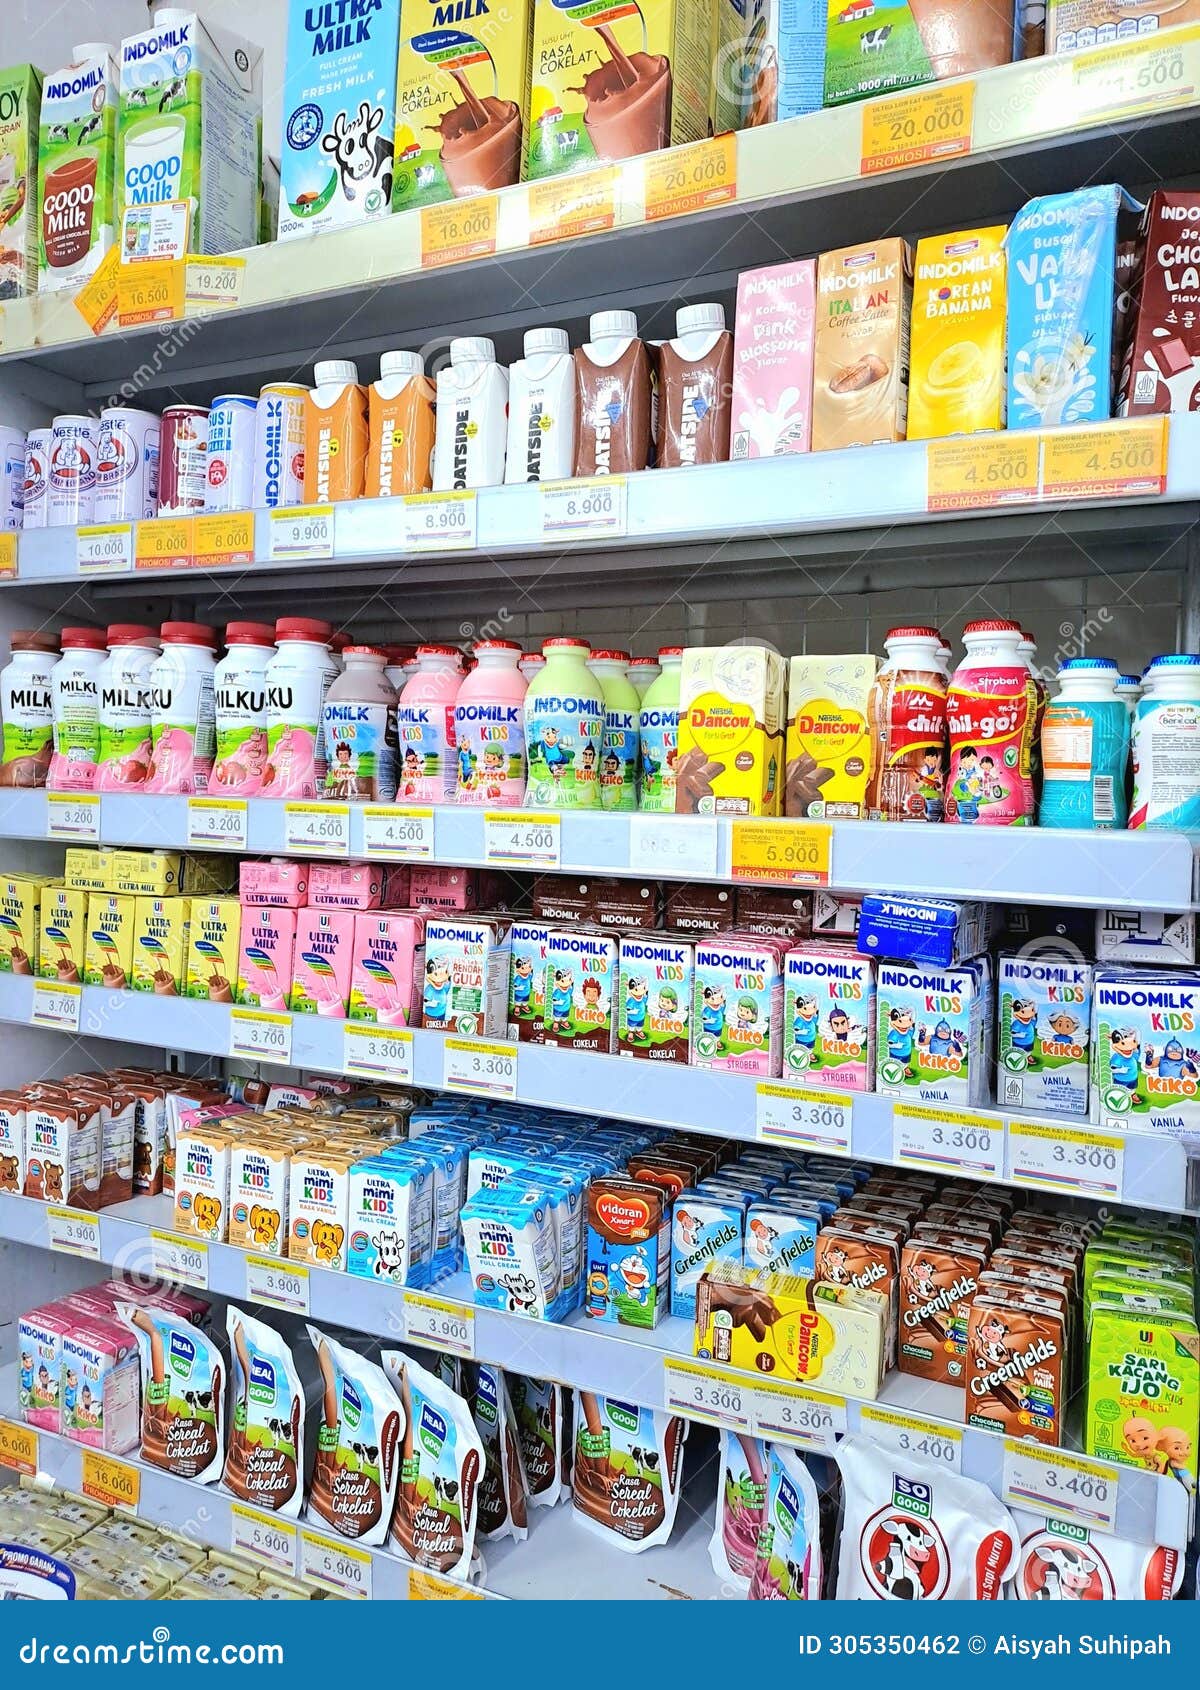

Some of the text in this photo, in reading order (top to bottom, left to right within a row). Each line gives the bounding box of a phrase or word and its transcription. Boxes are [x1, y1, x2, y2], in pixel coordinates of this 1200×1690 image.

[124, 24, 189, 62] INDOMILK
[312, 20, 373, 56] MILK
[320, 51, 362, 70] FULL CREAM
[540, 44, 573, 62] RASA
[540, 50, 592, 75] COKELAT
[302, 70, 375, 100] FRESH MILK
[402, 85, 430, 102] RASA
[401, 91, 448, 114] COKELAT
[890, 109, 964, 140] 20.000
[866, 150, 920, 170] PROMOSI
[126, 156, 180, 188] GOOD
[666, 160, 726, 190] 20.000
[43, 184, 93, 212] GOOD
[132, 180, 172, 204] Milk
[48, 206, 86, 234] Milk
[440, 216, 490, 240] 18.000
[919, 252, 1000, 280] INDOMILK
[198, 274, 236, 290] 19.200
[131, 288, 168, 304] 16.500
[928, 279, 992, 303] KOREAN
[828, 290, 889, 315] ITALIAN
[926, 296, 992, 319] BANANA
[120, 312, 152, 324] PROMOSI
[1085, 448, 1155, 472] 4.500
[964, 461, 1028, 484] 4.500
[1051, 484, 1118, 496] PROMOSI
[567, 498, 612, 516] 8.900
[931, 494, 994, 508] PROMOSI
[426, 512, 466, 529] 8.900
[215, 533, 248, 548] 8.000
[292, 524, 328, 540] 9.900
[88, 542, 124, 556] 10.000
[156, 538, 188, 550] 8.000
[138, 558, 171, 568] PROMOSI
[196, 554, 229, 566] PROMOSI
[691, 709, 750, 728] Dancow
[800, 716, 860, 734] Dancow
[64, 811, 93, 824] 3.200
[208, 817, 241, 831] 3.200
[306, 822, 342, 836] 4.500
[385, 826, 424, 840] 4.500
[510, 833, 553, 848] 4.500
[766, 846, 819, 863] 5.900
[737, 869, 788, 881] PROMOSI
[1, 897, 24, 910] ULTRA
[246, 894, 289, 904] ULTRA MILK
[315, 895, 360, 905] ULTRA MILK
[50, 908, 73, 920] ULTRA
[146, 917, 171, 928] ULTRA
[148, 927, 168, 938] MILK
[201, 921, 227, 933] ULTRA
[251, 928, 279, 940] ULTRA
[427, 926, 484, 944] INDOMILK
[203, 931, 224, 942] MILK
[254, 938, 276, 950] MILK
[309, 932, 340, 944] ULTRA
[368, 938, 398, 952] ULTRA
[312, 943, 337, 955] MILK
[549, 937, 609, 956] INDOMILK
[622, 945, 684, 963] INDOMILK
[372, 950, 395, 962] MILK
[697, 952, 766, 972] INDOMILK
[452, 962, 483, 974] RENDAH
[788, 959, 863, 980] INDOMILK
[452, 972, 482, 987] GULA
[881, 971, 963, 994] INDOMILK
[48, 999, 76, 1015] 3.700
[1099, 989, 1194, 1010] INDOMILK
[251, 1029, 285, 1046] 3.700
[572, 1038, 598, 1048] COKELAT
[368, 1042, 405, 1059] 3.300
[648, 1048, 676, 1059] COKELAT
[472, 1056, 512, 1076] 3.300
[727, 1059, 760, 1070] STROBERI
[822, 1072, 857, 1083] STROBERI
[1042, 1076, 1071, 1086] VANILA
[920, 1090, 949, 1101] VANILA
[792, 1106, 844, 1128] 3.300
[1150, 1117, 1185, 1128] VANILA
[35, 1124, 57, 1135] mimi
[36, 1133, 58, 1147] KIDS
[932, 1128, 991, 1152] 3.300
[187, 1152, 213, 1166] mimi
[1052, 1145, 1116, 1170] 3.300
[187, 1162, 212, 1177] KIDS
[242, 1162, 270, 1176] mimi
[242, 1173, 270, 1189] KIDS
[304, 1176, 334, 1190] mimi
[304, 1187, 334, 1203] KIDS
[363, 1186, 394, 1200] mimi
[362, 1198, 394, 1214] KIDS
[601, 1204, 643, 1219] vidoran
[610, 1216, 635, 1226] Xmart
[66, 1225, 96, 1242] 3.900
[479, 1230, 513, 1244] mimi
[480, 1241, 516, 1258] KIDS
[674, 1223, 739, 1277] Greenfields
[170, 1251, 202, 1269] 3.900
[480, 1260, 521, 1270] FULL CREAM
[592, 1262, 606, 1272] UHT
[266, 1275, 301, 1296] 3.900
[904, 1275, 978, 1328] Greenfields
[429, 1318, 467, 1340] 3.900
[172, 1339, 193, 1354] REAL
[172, 1360, 192, 1373] GOOD
[970, 1337, 1058, 1397] Greenfields
[1124, 1354, 1166, 1372] SARI
[1108, 1364, 1180, 1392] KACANG
[249, 1388, 274, 1400] GOOD
[344, 1383, 360, 1406] REAL
[694, 1386, 742, 1412] 3.300
[175, 1418, 193, 1428] Rasa
[424, 1410, 446, 1432] REAL
[612, 1411, 637, 1428] GOOD
[970, 1415, 1004, 1429] Chocolate
[167, 1424, 205, 1442] Sereal
[166, 1441, 210, 1458] Cokelat
[255, 1448, 274, 1458] Rasa
[899, 1433, 955, 1462] 3.400
[247, 1454, 285, 1472] Sereal
[94, 1469, 134, 1496] 16.000
[246, 1472, 290, 1491] Cokelat
[340, 1469, 359, 1481] Rasa
[619, 1474, 640, 1486] Rasa
[333, 1478, 369, 1496] Sereal
[611, 1482, 652, 1500] Sereal
[898, 1480, 928, 1498] SO
[1045, 1470, 1108, 1502] 3.400
[84, 1486, 118, 1504] PROMOSI
[332, 1496, 376, 1515] Cokelat
[422, 1503, 438, 1518] Rasa
[610, 1500, 658, 1518] Cokelat
[896, 1496, 928, 1516] GOOD
[413, 1510, 450, 1533] Sereal
[1051, 1520, 1086, 1538] GOOD
[253, 1529, 289, 1554] 5.900
[412, 1532, 457, 1553] Cokelat
[323, 1558, 362, 1582] 5.900
[1162, 1548, 1177, 1581] Murni
